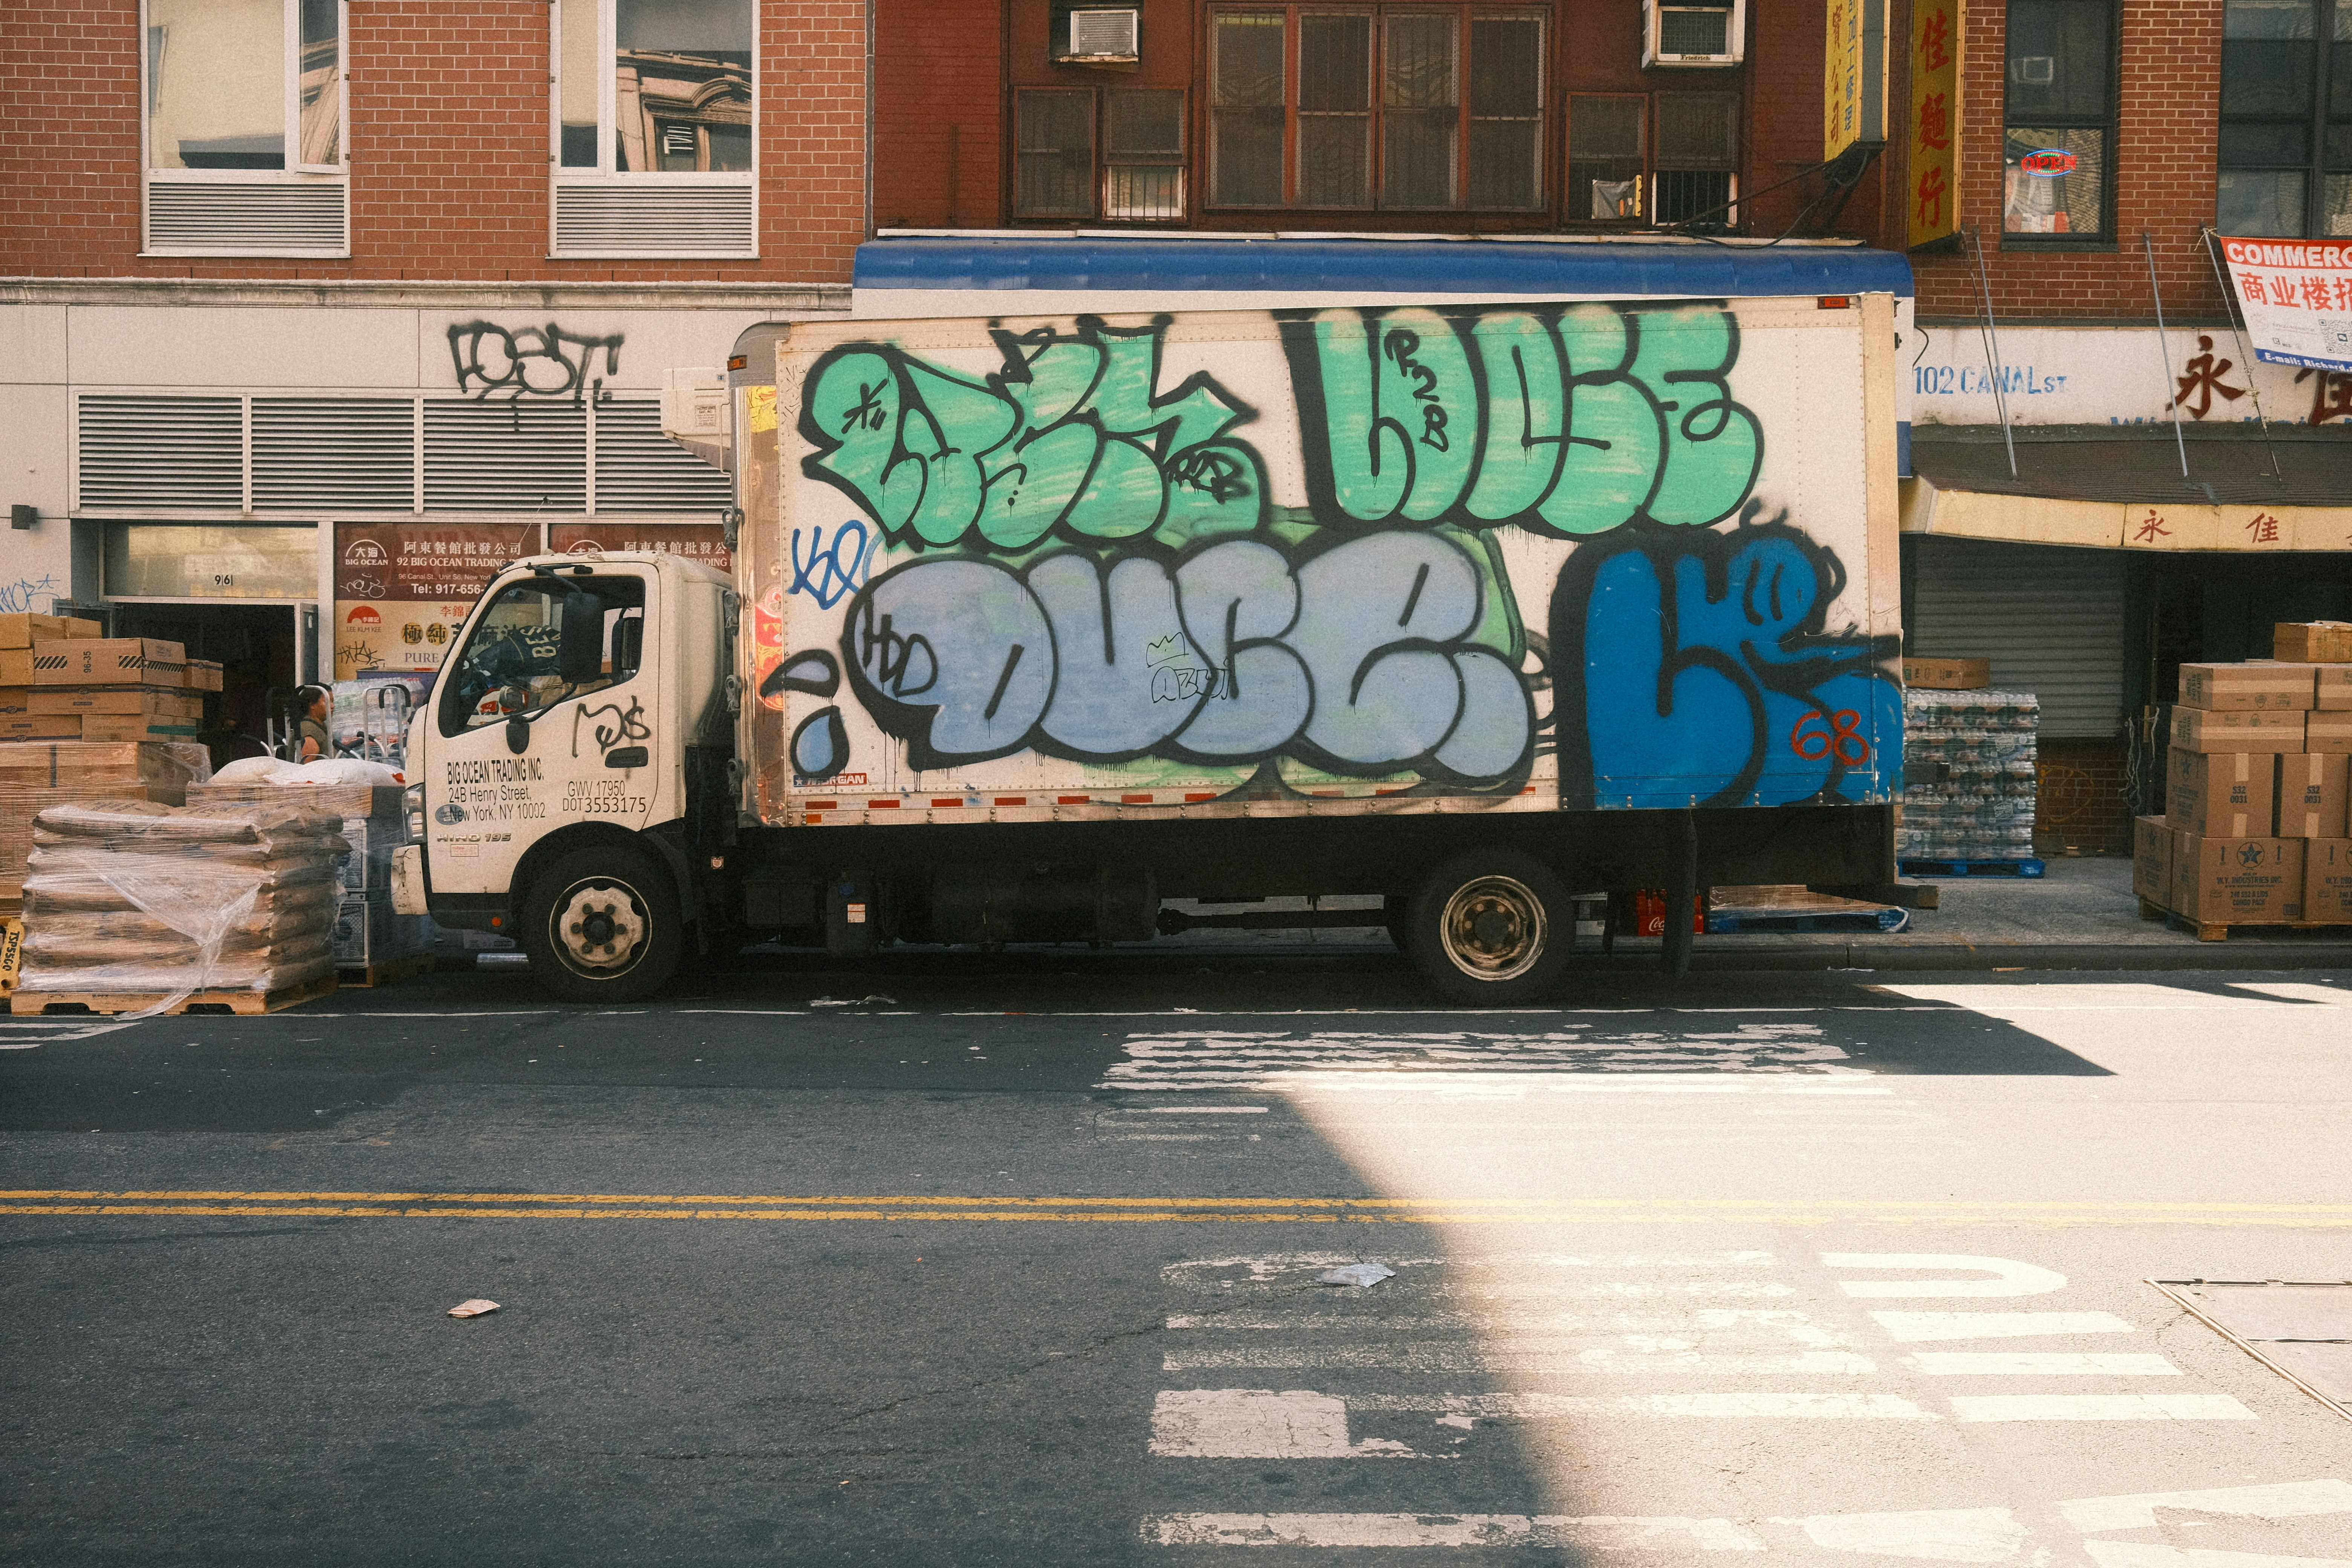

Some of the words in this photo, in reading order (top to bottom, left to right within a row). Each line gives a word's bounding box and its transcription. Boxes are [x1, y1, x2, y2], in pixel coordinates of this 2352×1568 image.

[2021, 154, 2077, 171] OPEN
[2228, 243, 2352, 267] COMMERC
[2265, 352, 2301, 365] E-mail:
[1914, 366, 1954, 394] 102
[1961, 366, 2042, 394] CANAL
[2044, 377, 2067, 393] ST
[355, 547, 378, 557] 大海
[404, 541, 522, 555] 阿東餐館批發公司
[429, 558, 462, 566] OCEAN
[465, 558, 506, 567] TRADING
[692, 558, 727, 567] ADING
[411, 583, 432, 594] Tel:
[436, 584, 487, 594] 917-656-
[83, 651, 92, 673] 96-35
[405, 653, 439, 663] PURE
[1791, 709, 1869, 766] 68
[447, 762, 460, 785] BIG
[462, 760, 490, 784] OCEAN
[491, 758, 527, 782] TRADING
[528, 758, 544, 781] INC.
[449, 787, 467, 803] 24B
[470, 786, 498, 805] Henry
[501, 784, 532, 802] Street,
[568, 781, 593, 797] GWV
[596, 780, 625, 796] 17950
[2307, 786, 2320, 794] S32
[2230, 795, 2247, 804] 0031
[2304, 795, 2321, 804] 0031
[450, 806, 470, 822] New
[473, 805, 496, 822] York,
[499, 804, 513, 820] NY
[517, 802, 546, 819] 10002
[437, 833, 481, 842] HINO
[485, 833, 512, 842] 195
